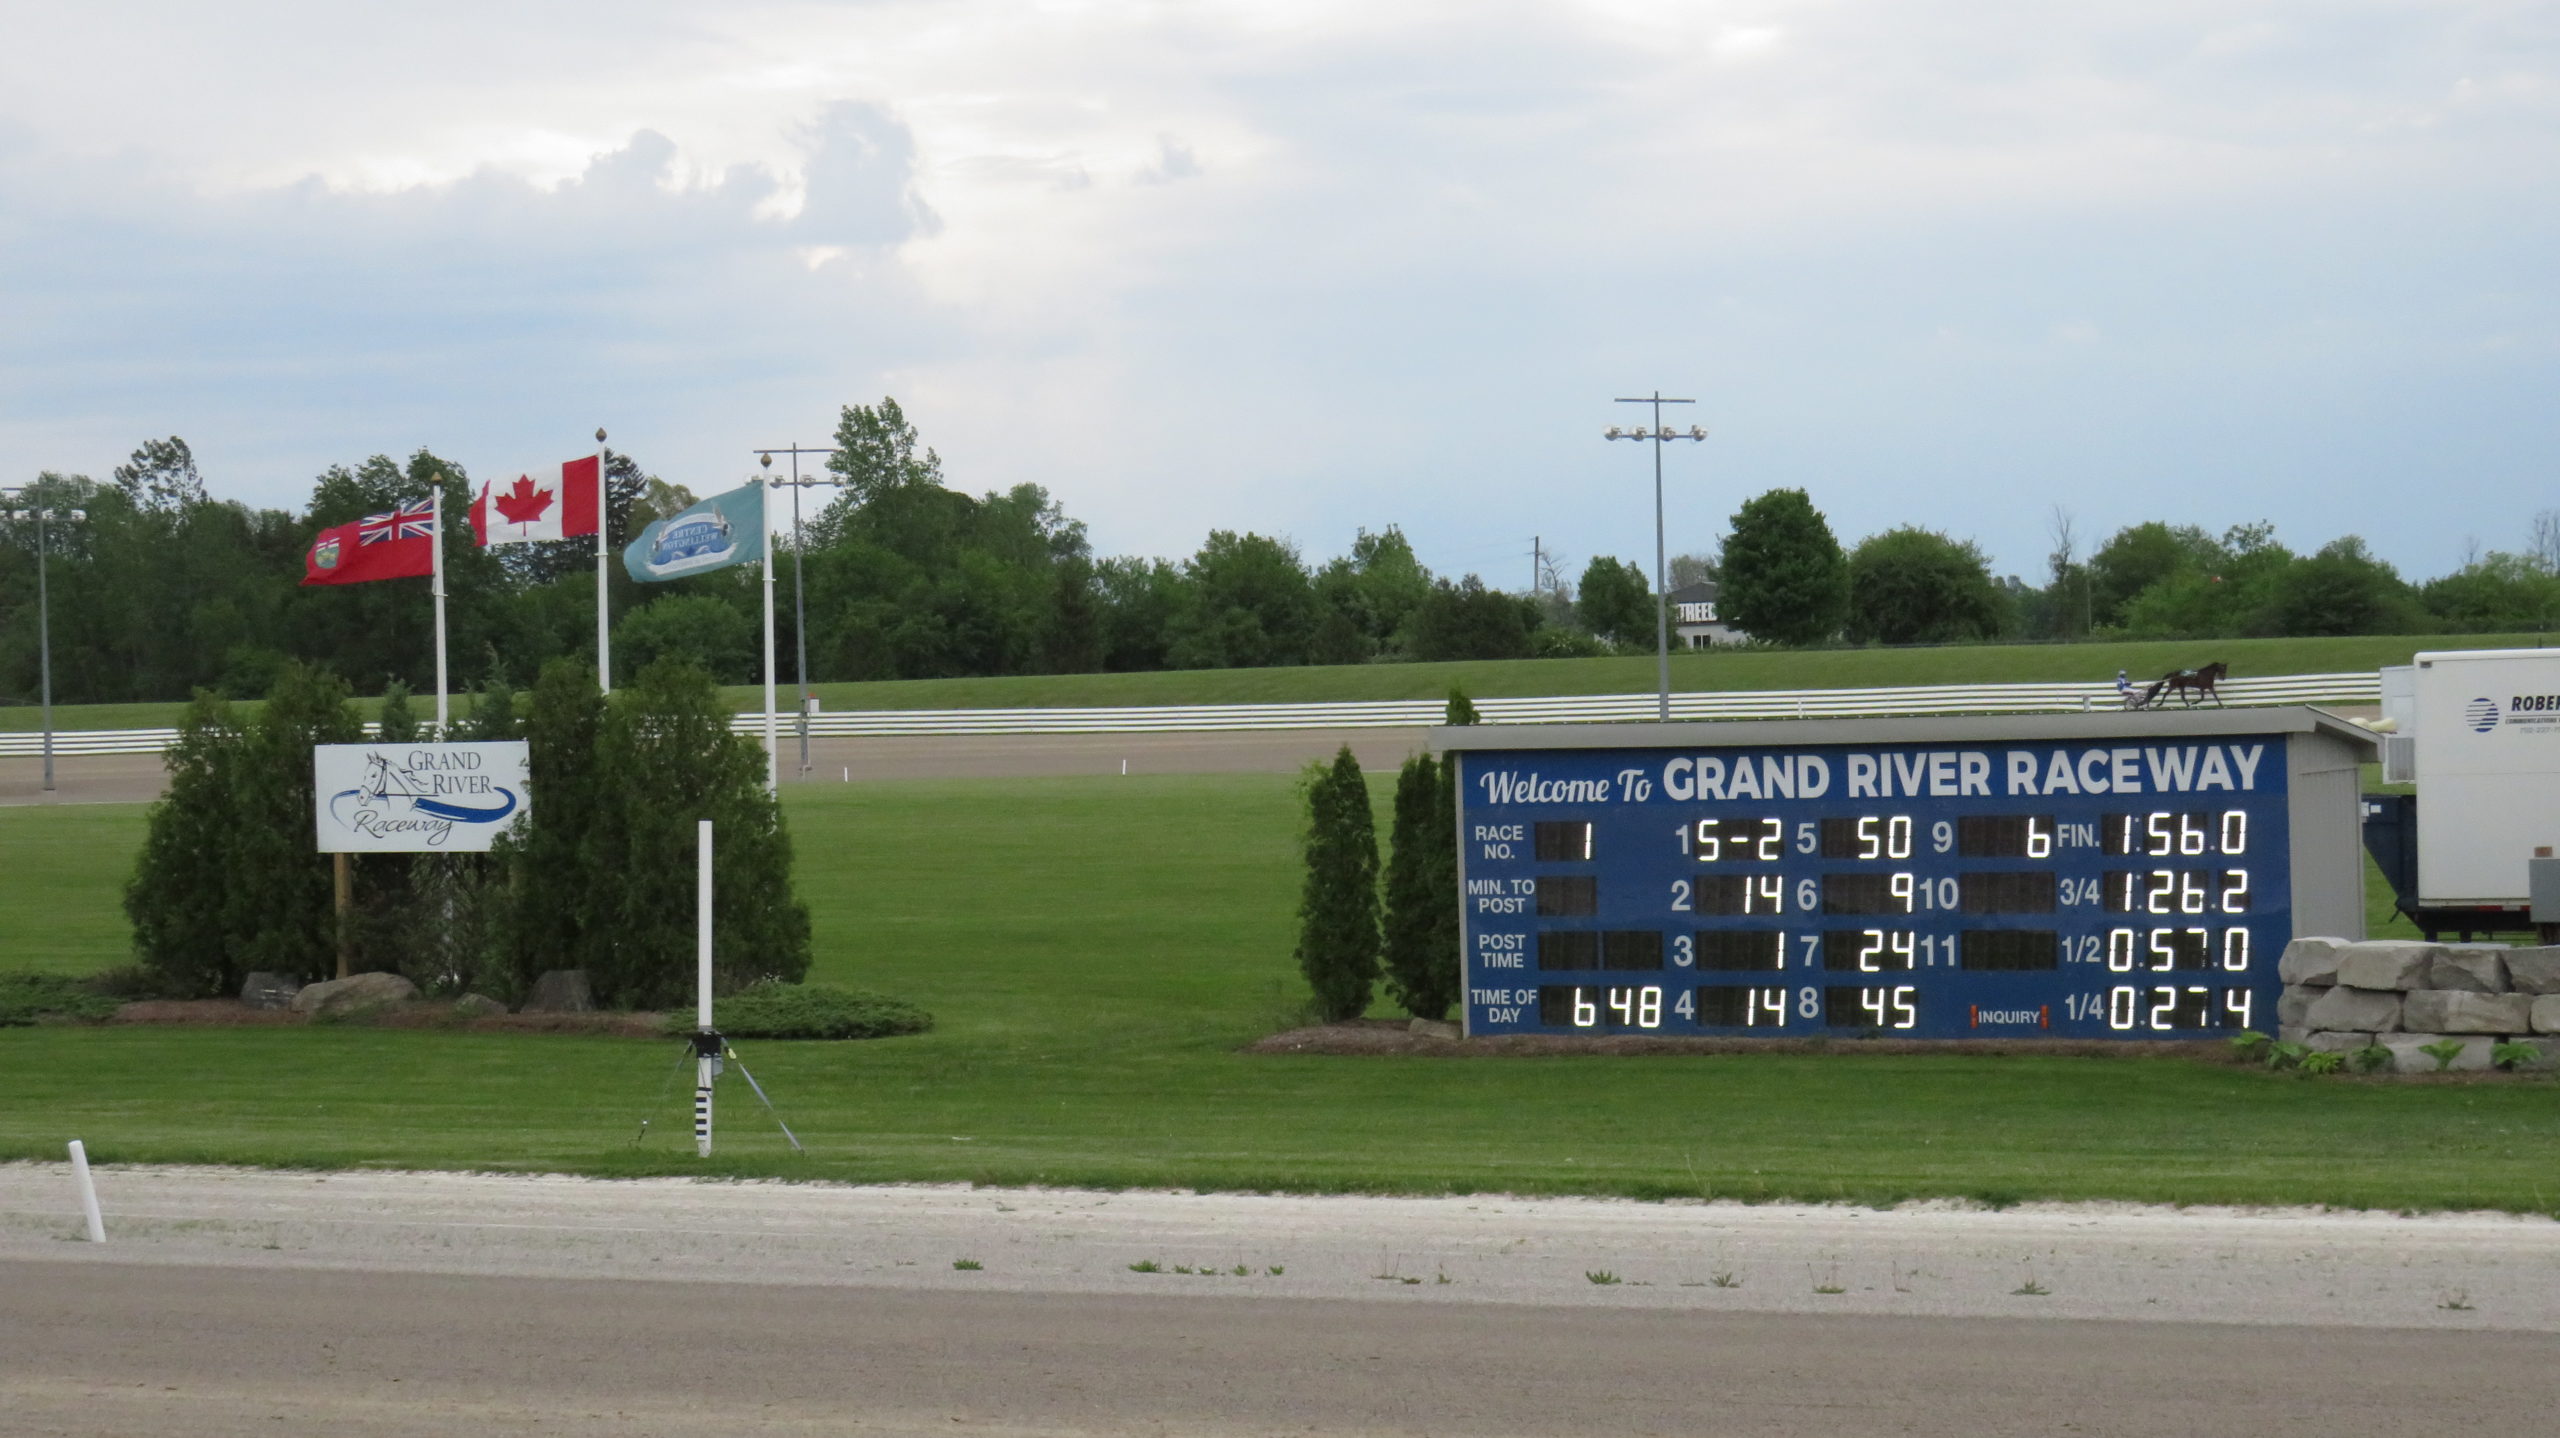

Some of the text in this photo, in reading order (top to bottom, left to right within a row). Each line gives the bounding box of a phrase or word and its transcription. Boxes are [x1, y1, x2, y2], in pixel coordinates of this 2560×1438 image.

[408, 750, 481, 771] GRAND
[1479, 745, 2263, 804] Welcome To GRAND RIVER RACEWAY
[433, 774, 494, 794] RIVER
[353, 809, 453, 846] Raceway
[1475, 825, 1523, 841] RACE
[1584, 822, 1592, 860] 1
[1675, 824, 1689, 855] 1
[1697, 817, 1783, 862] 5-2
[1796, 822, 1817, 854] 5
[1856, 815, 1914, 861] 50
[1932, 821, 1953, 853] 9
[2026, 816, 2052, 859] 6
[2057, 823, 2100, 848] FIN.
[1484, 843, 1515, 860] NO.
[1467, 879, 1535, 896] MIN. TO
[1671, 879, 1691, 911] 2
[1744, 875, 1783, 915] 14
[1797, 878, 1817, 911] 6
[1890, 871, 1915, 914] 9
[1919, 877, 1959, 910] 10
[2060, 878, 2100, 906] 3/4
[1479, 897, 1526, 914] POST
[1479, 934, 1526, 950] POST
[1674, 935, 1693, 967] 3
[1777, 931, 1785, 970] 1
[1800, 935, 1819, 966] 7
[1859, 928, 1916, 973] 24
[1920, 934, 1955, 966] 11
[2061, 935, 2101, 962] 1/2
[1480, 952, 1524, 968] TIME
[1471, 989, 1537, 1005] TIME OF
[1674, 990, 1695, 1020] 4
[1747, 988, 1787, 1027] 14
[1798, 986, 1819, 1019] 8
[1861, 985, 1916, 1029] 45
[2065, 993, 2104, 1021] 1/4
[1489, 1007, 1521, 1023] DAY
[1978, 1010, 2039, 1024] INQUIRY
